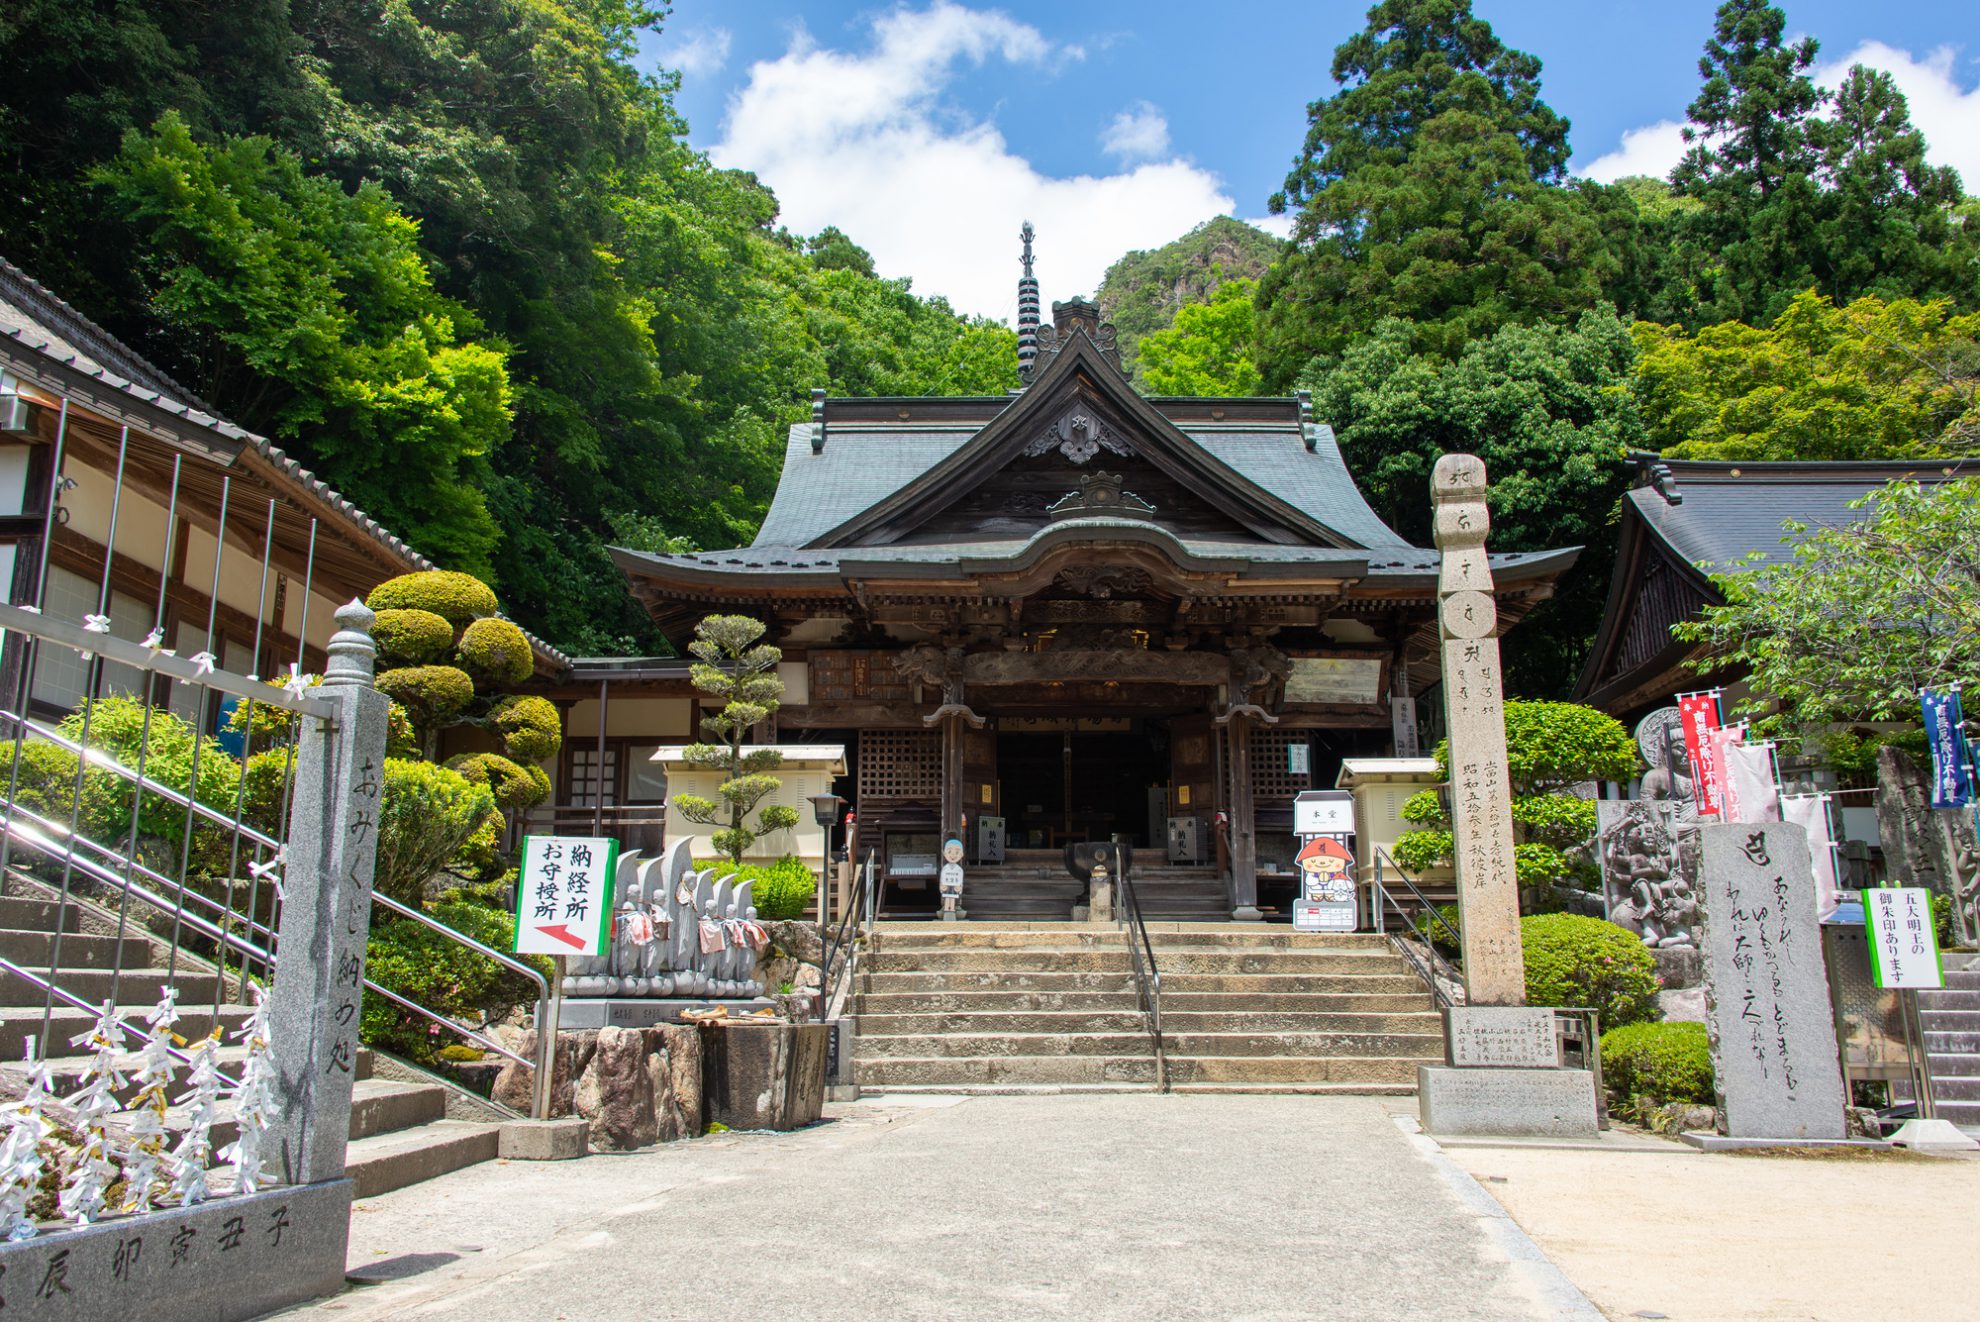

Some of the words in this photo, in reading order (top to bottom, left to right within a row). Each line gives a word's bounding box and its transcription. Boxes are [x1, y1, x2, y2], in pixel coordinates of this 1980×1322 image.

[534, 843, 562, 921] お守授所
[565, 844, 592, 922] 納経所
[1879, 892, 1903, 983] 御朱印あります
[1905, 892, 1925, 954] 五大明王の
